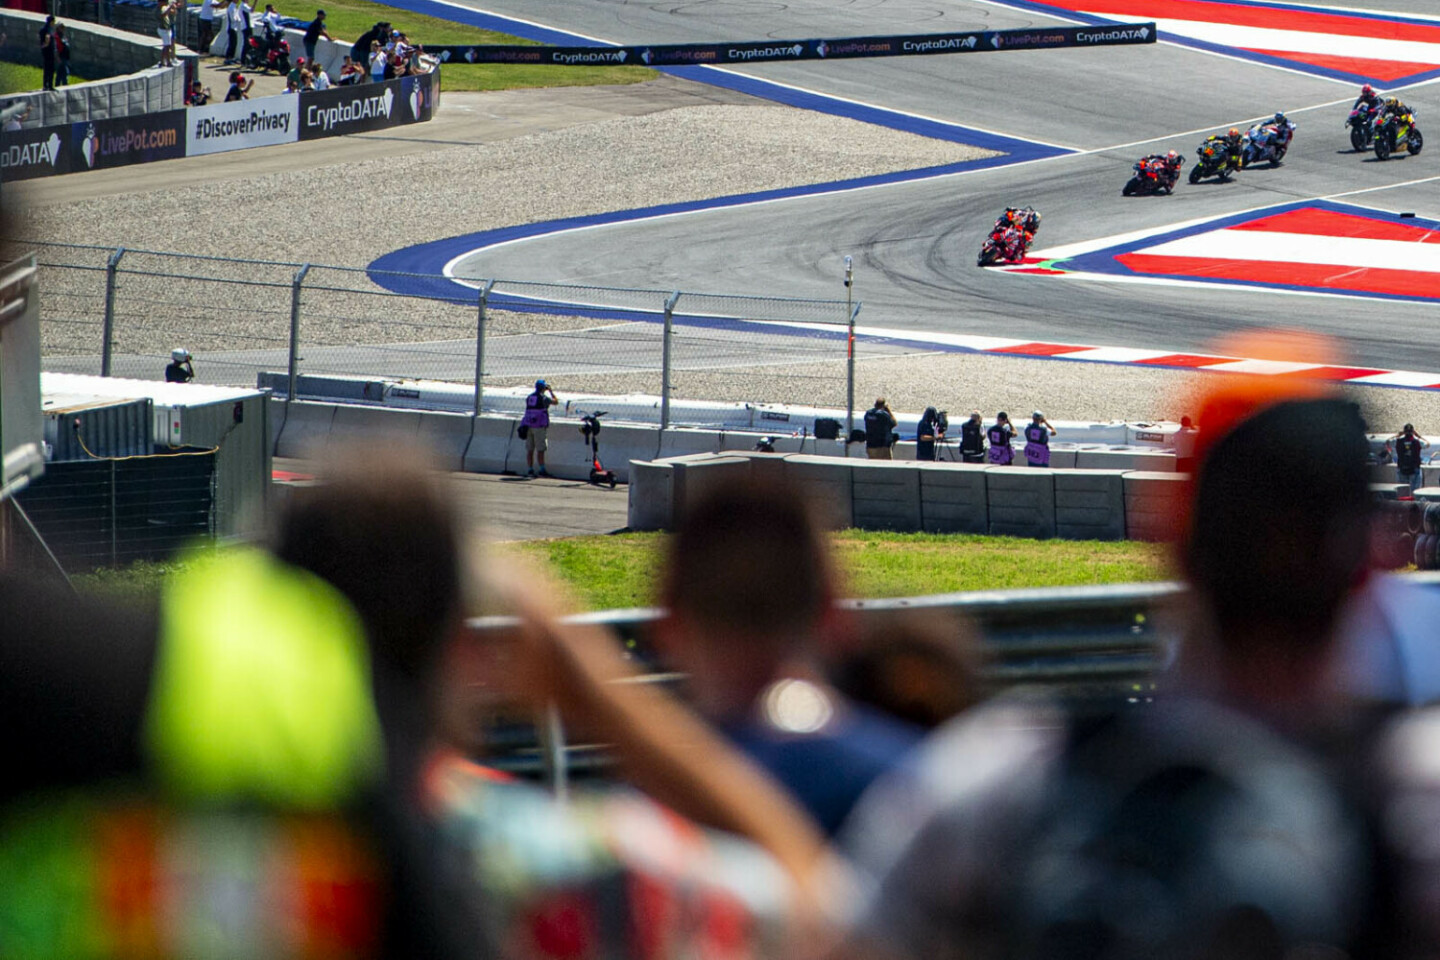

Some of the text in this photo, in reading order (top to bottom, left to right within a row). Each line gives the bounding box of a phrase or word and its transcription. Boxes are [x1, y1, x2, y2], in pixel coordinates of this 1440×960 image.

[552, 51, 619, 64] CryptoDATA
[728, 47, 795, 59] CryptoDATA
[831, 42, 891, 53] LivePot.com
[903, 38, 970, 51] CryptoDATA
[1005, 33, 1065, 45] LivePot.com
[1076, 29, 1142, 42] CryptoDATA
[1, 95, 386, 167] oDATA LivePot.com #DiscoverPrivacy CryptoDATA
